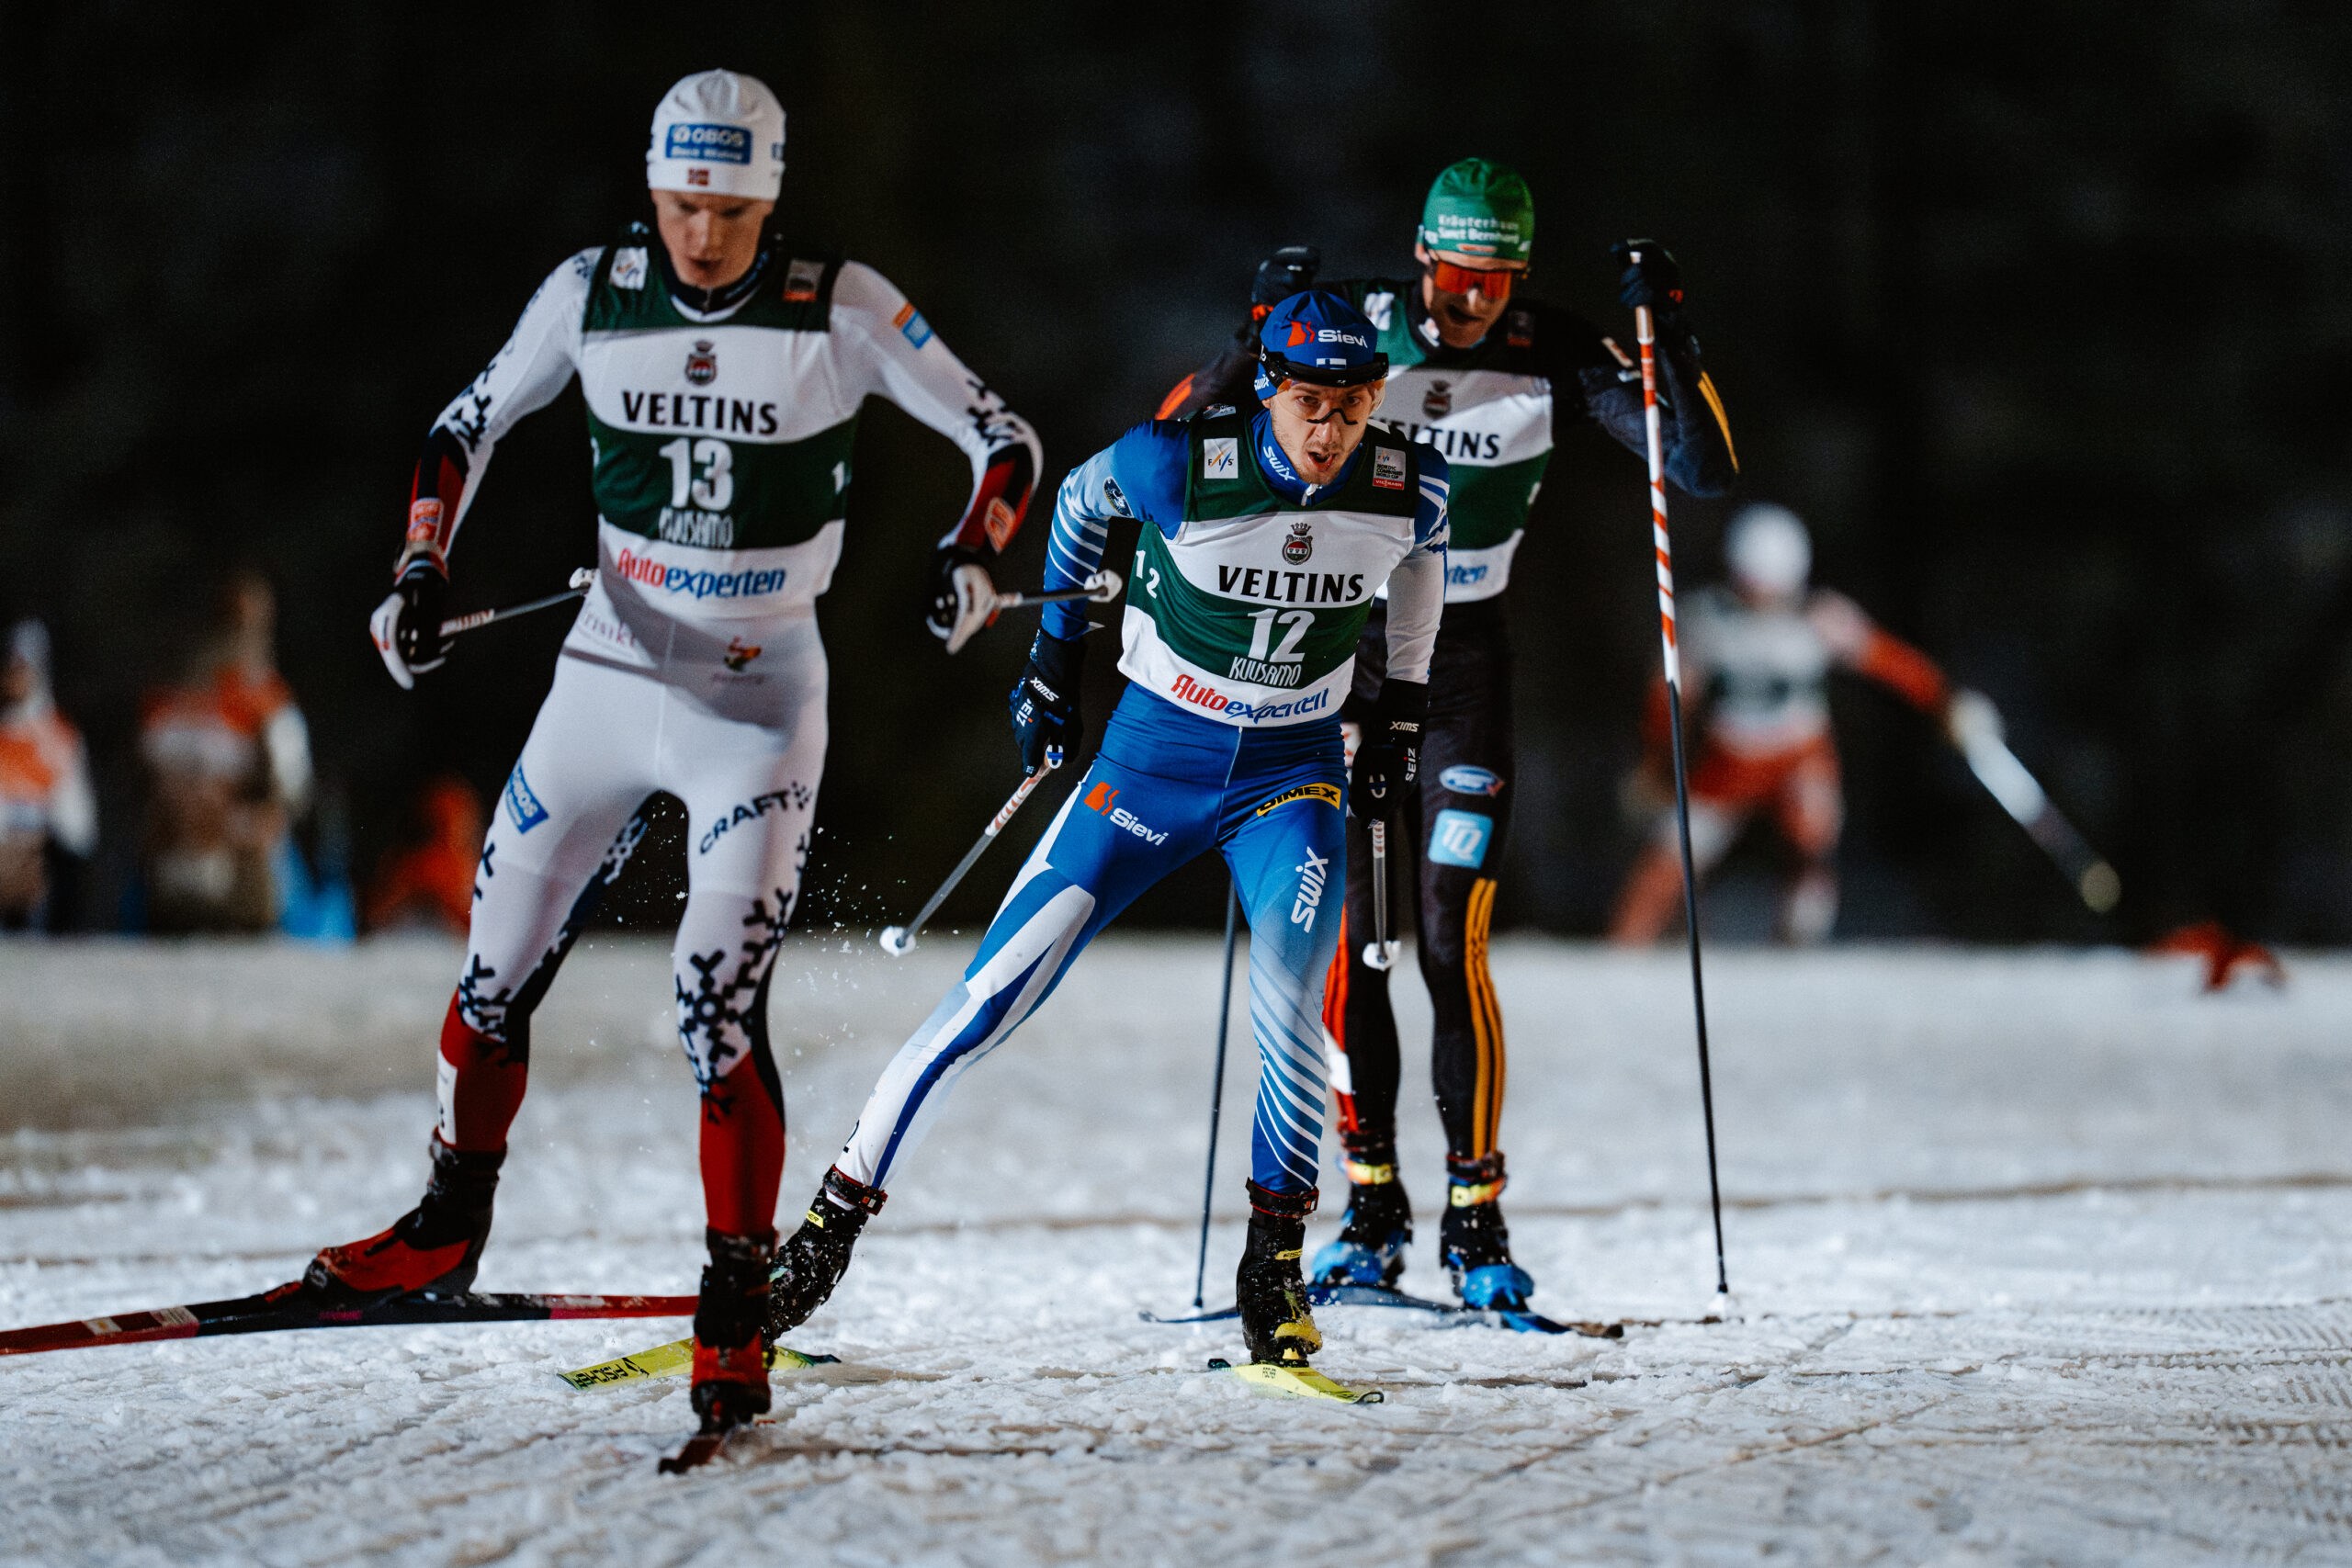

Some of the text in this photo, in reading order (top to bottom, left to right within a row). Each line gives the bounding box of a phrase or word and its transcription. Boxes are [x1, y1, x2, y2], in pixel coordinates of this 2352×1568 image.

[1317, 329, 1369, 349] Sievi
[622, 390, 778, 435] VELTINS
[659, 437, 733, 512] 13
[617, 547, 786, 600] Autoexperten
[1218, 564, 1364, 604] VELTINS
[1247, 607, 1316, 663] 12
[1227, 656, 1302, 687] KUUSAMO
[1404, 747, 1417, 783] SEIZ
[699, 790, 790, 854] CRAFT
[1109, 807, 1170, 846] Sievi
[572, 1363, 630, 1390] FISCHER
